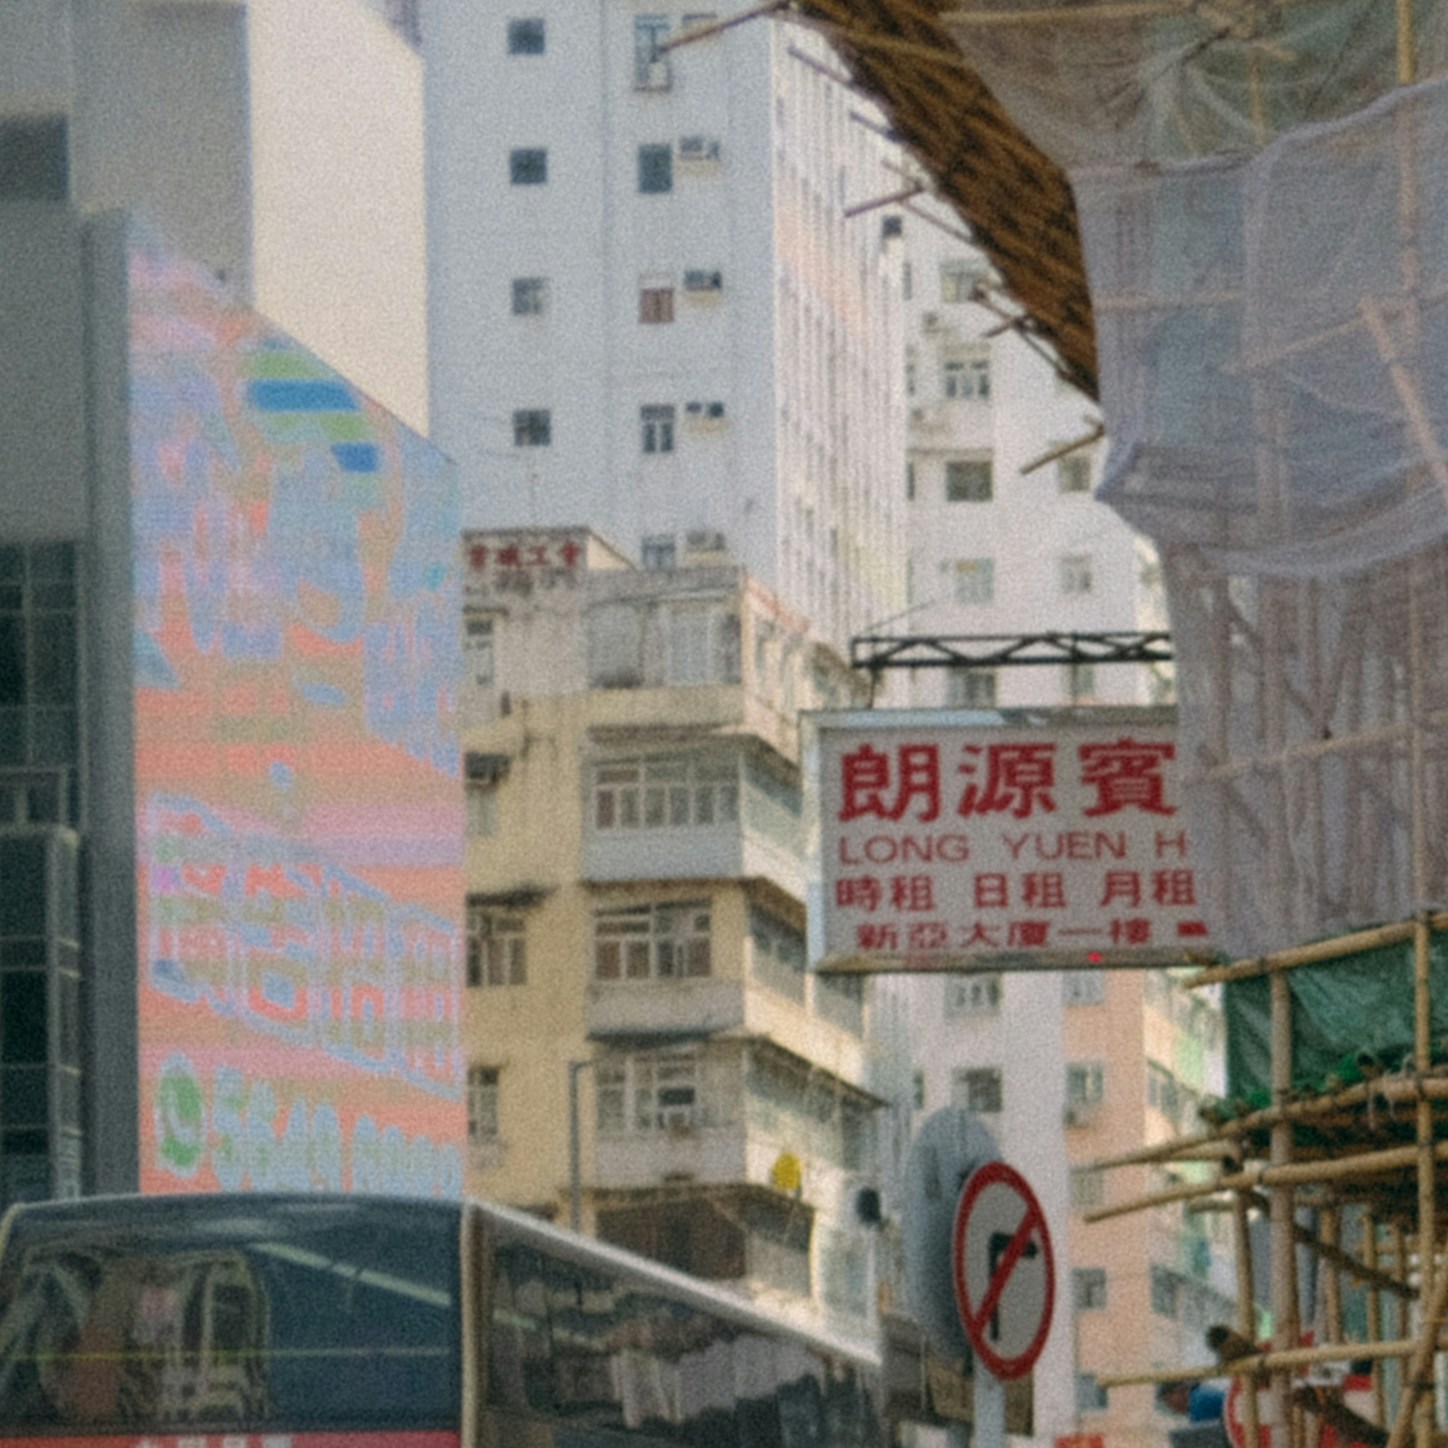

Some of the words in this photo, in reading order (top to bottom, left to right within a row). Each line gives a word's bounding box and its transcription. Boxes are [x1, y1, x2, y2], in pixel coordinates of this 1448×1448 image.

[838, 737, 1177, 823] 朗源賓
[838, 833, 970, 865] LONG
[1002, 830, 1128, 861] YUEN
[835, 873, 936, 912] 時租
[974, 871, 1066, 910] 日租
[1102, 868, 1197, 908] 月租
